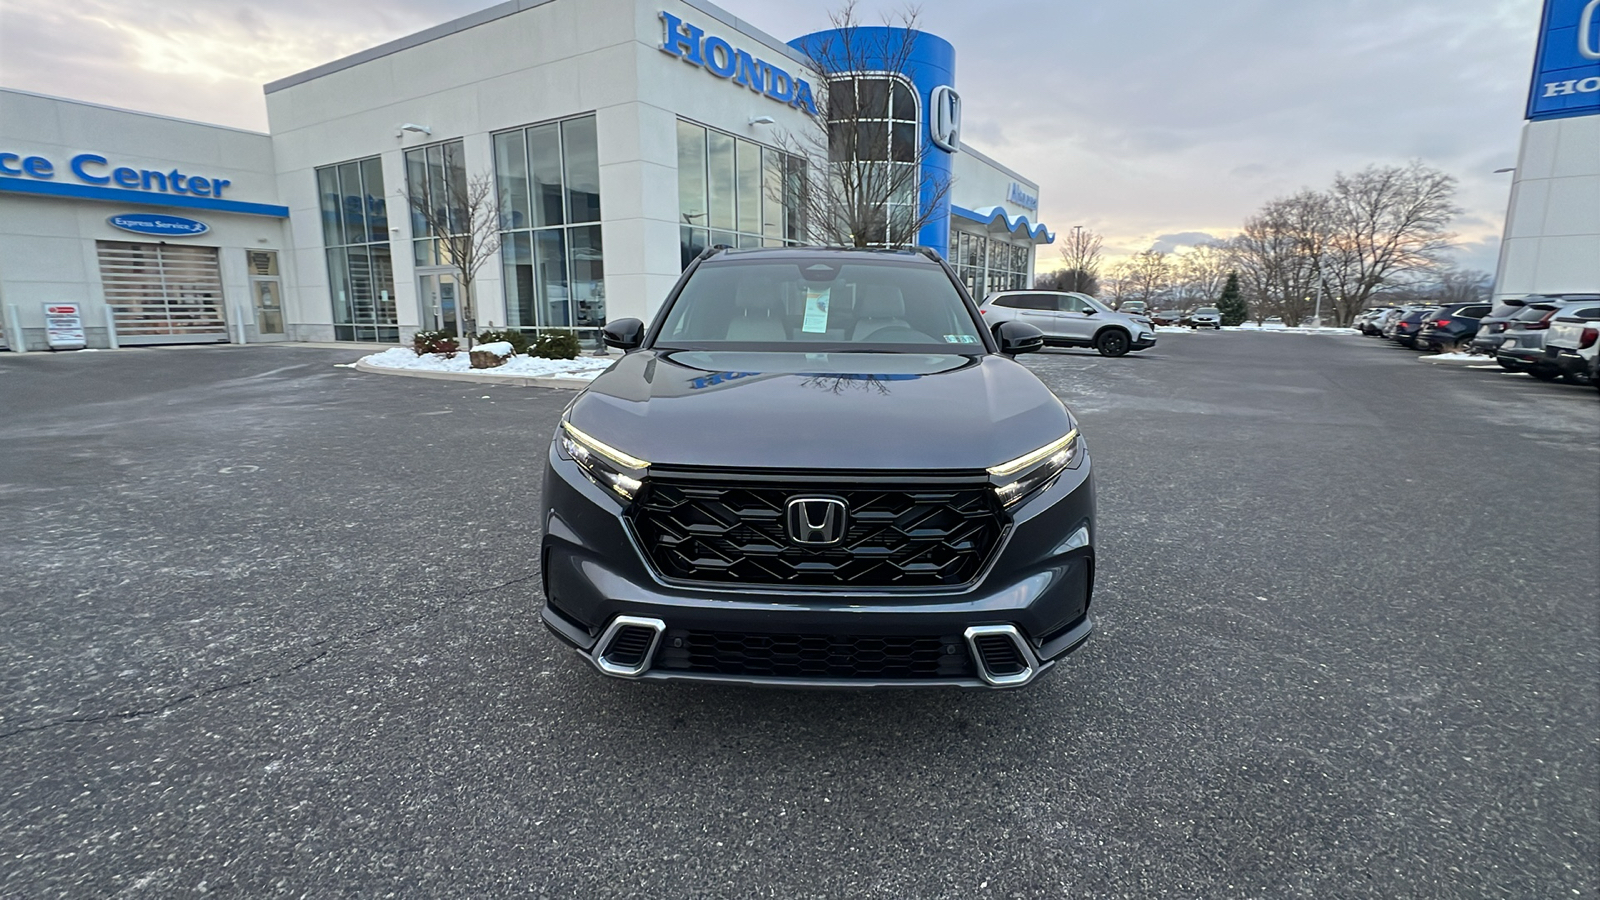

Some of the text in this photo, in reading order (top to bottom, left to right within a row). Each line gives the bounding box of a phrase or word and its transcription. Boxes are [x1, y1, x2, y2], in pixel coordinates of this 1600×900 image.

[658, 11, 818, 116] HONDA
[70, 154, 231, 198] Center
[115, 218, 190, 230] Express Service
